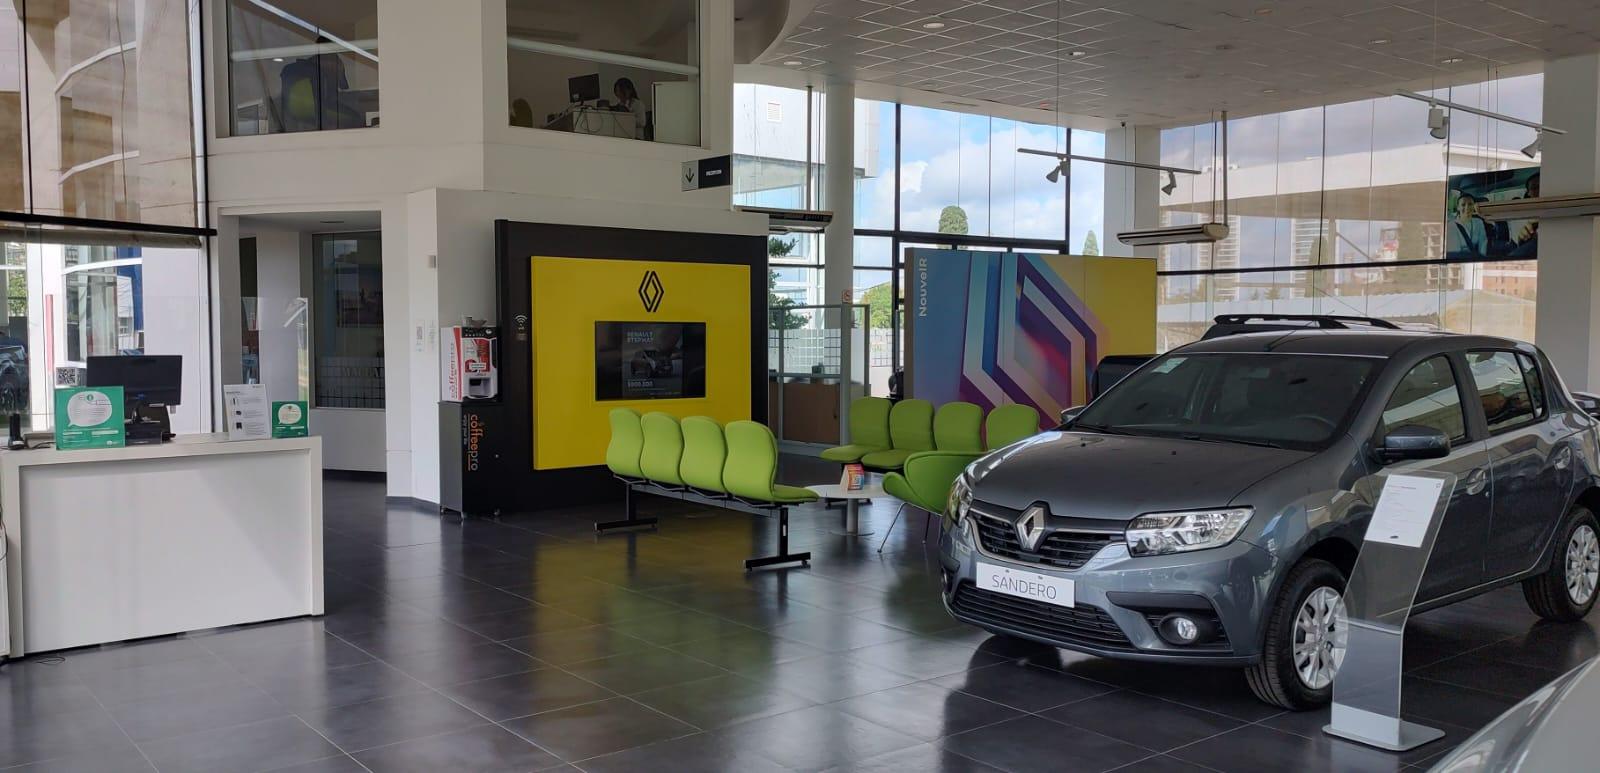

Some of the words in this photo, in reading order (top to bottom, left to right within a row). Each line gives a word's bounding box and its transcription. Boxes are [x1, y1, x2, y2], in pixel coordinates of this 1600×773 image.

[918, 257, 928, 317] NouvelR
[468, 414, 484, 471] coffeepro
[991, 574, 1057, 600] SANDERO
